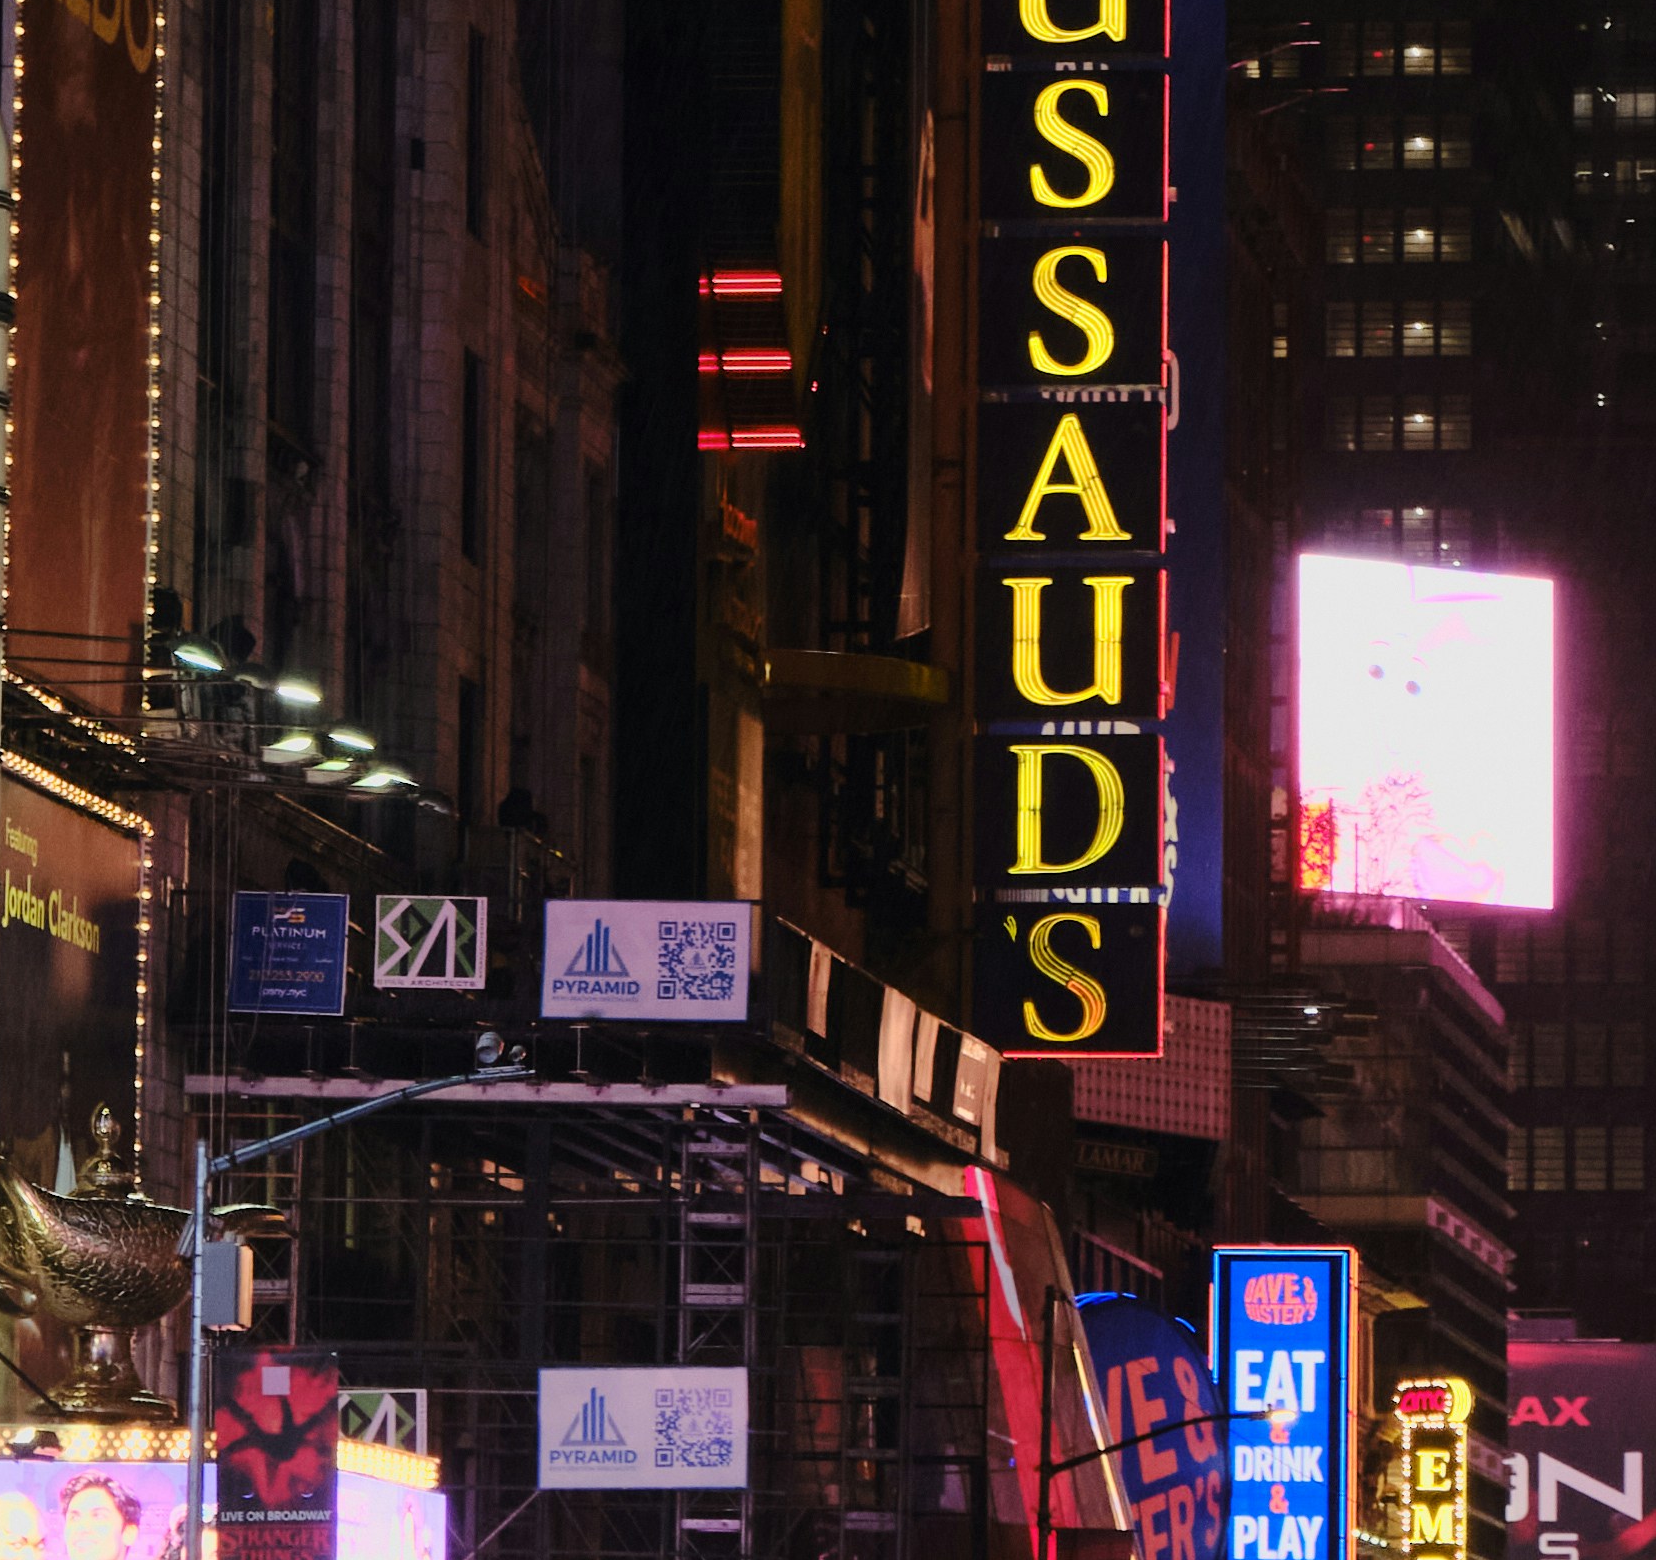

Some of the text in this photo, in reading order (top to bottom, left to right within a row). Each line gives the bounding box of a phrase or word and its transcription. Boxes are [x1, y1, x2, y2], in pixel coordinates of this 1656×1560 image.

[6, 817, 39, 867] Featuring
[1, 869, 100, 954] Jordan Clarkson
[551, 979, 641, 995] PYRAMID
[1233, 1349, 1326, 1413] EAT
[1399, 1388, 1446, 1411] amc
[549, 1450, 638, 1463] PYRAMID
[1233, 1445, 1324, 1484] DRINK
[1268, 1483, 1290, 1515] &
[221, 1509, 332, 1522] LIVE ON BROADWAY
[217, 1525, 331, 1557] STRANGER
